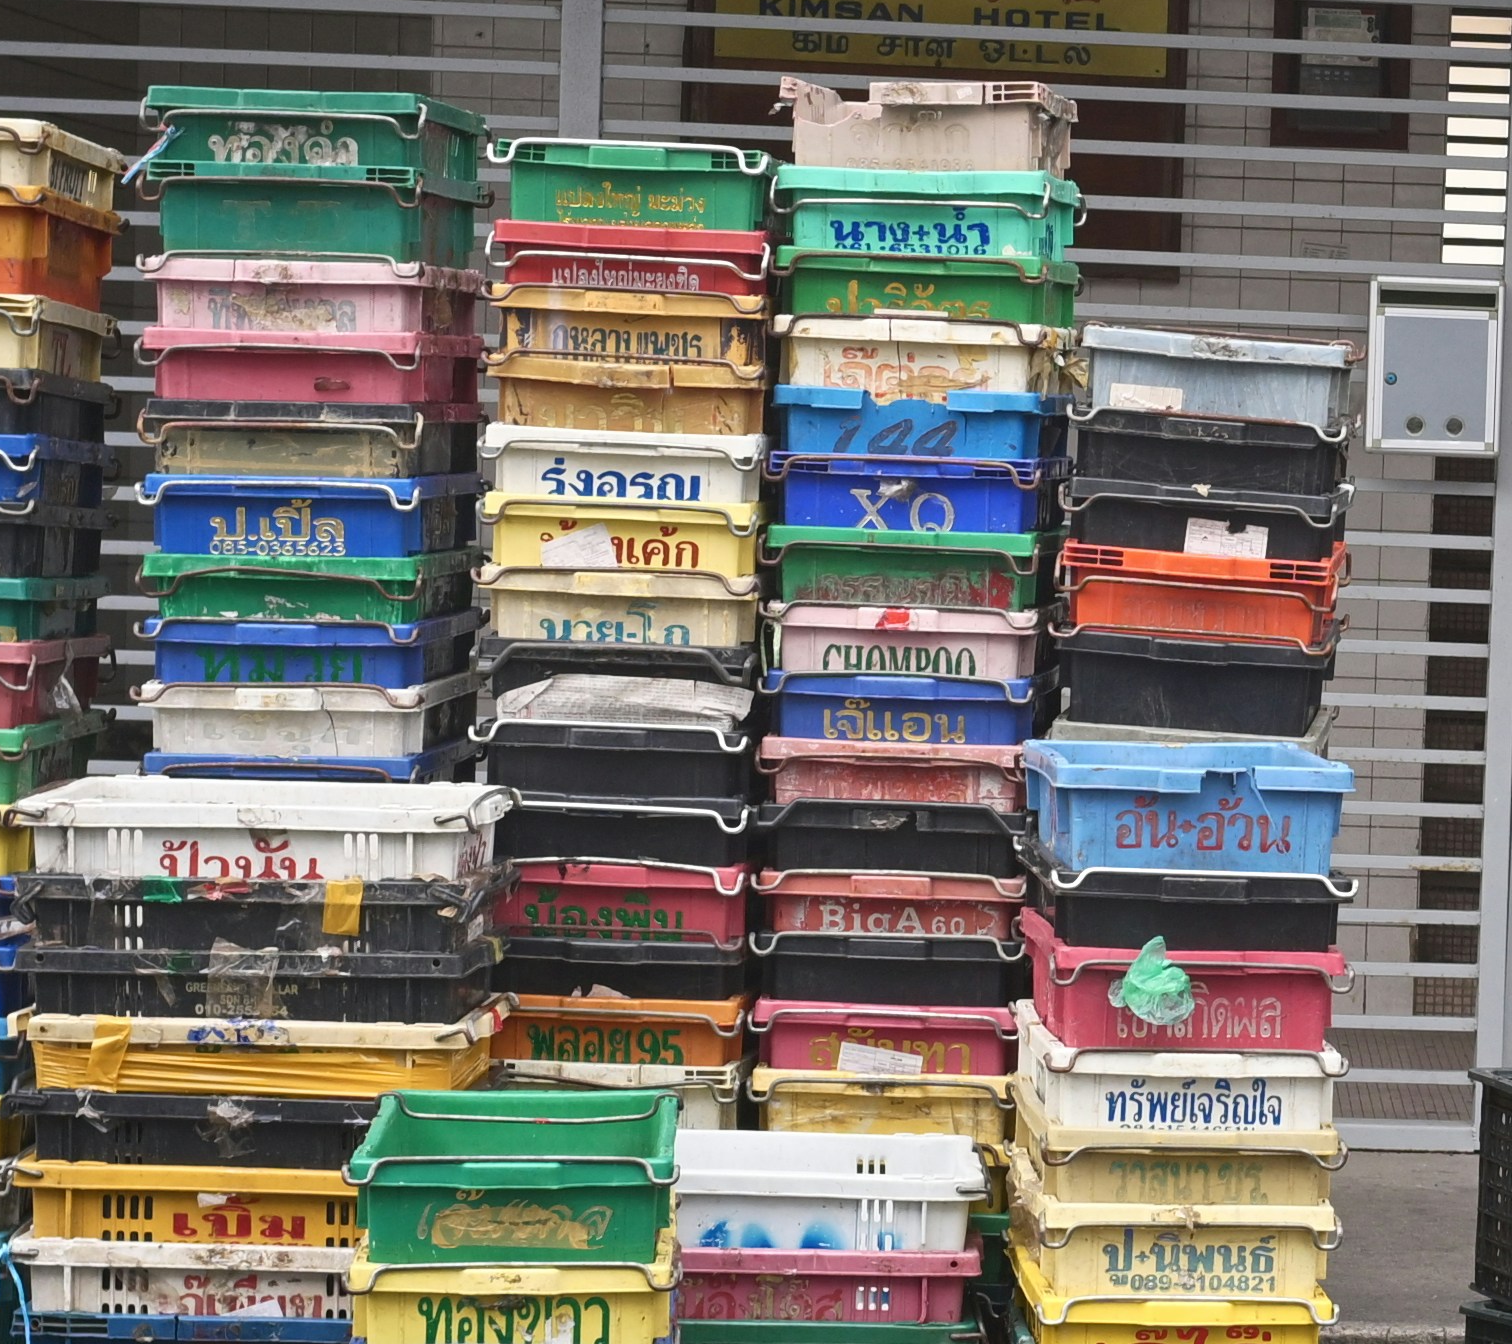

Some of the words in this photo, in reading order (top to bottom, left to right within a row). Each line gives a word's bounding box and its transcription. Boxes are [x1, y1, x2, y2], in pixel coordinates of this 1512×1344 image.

[974, 7, 1122, 34] HOTEL
[823, 699, 966, 743] เจ๊แอน
[528, 1025, 634, 1064] พลอย
[637, 1027, 685, 1066] 95
[1105, 1078, 1283, 1126] ทรัพย์เจริญใจ
